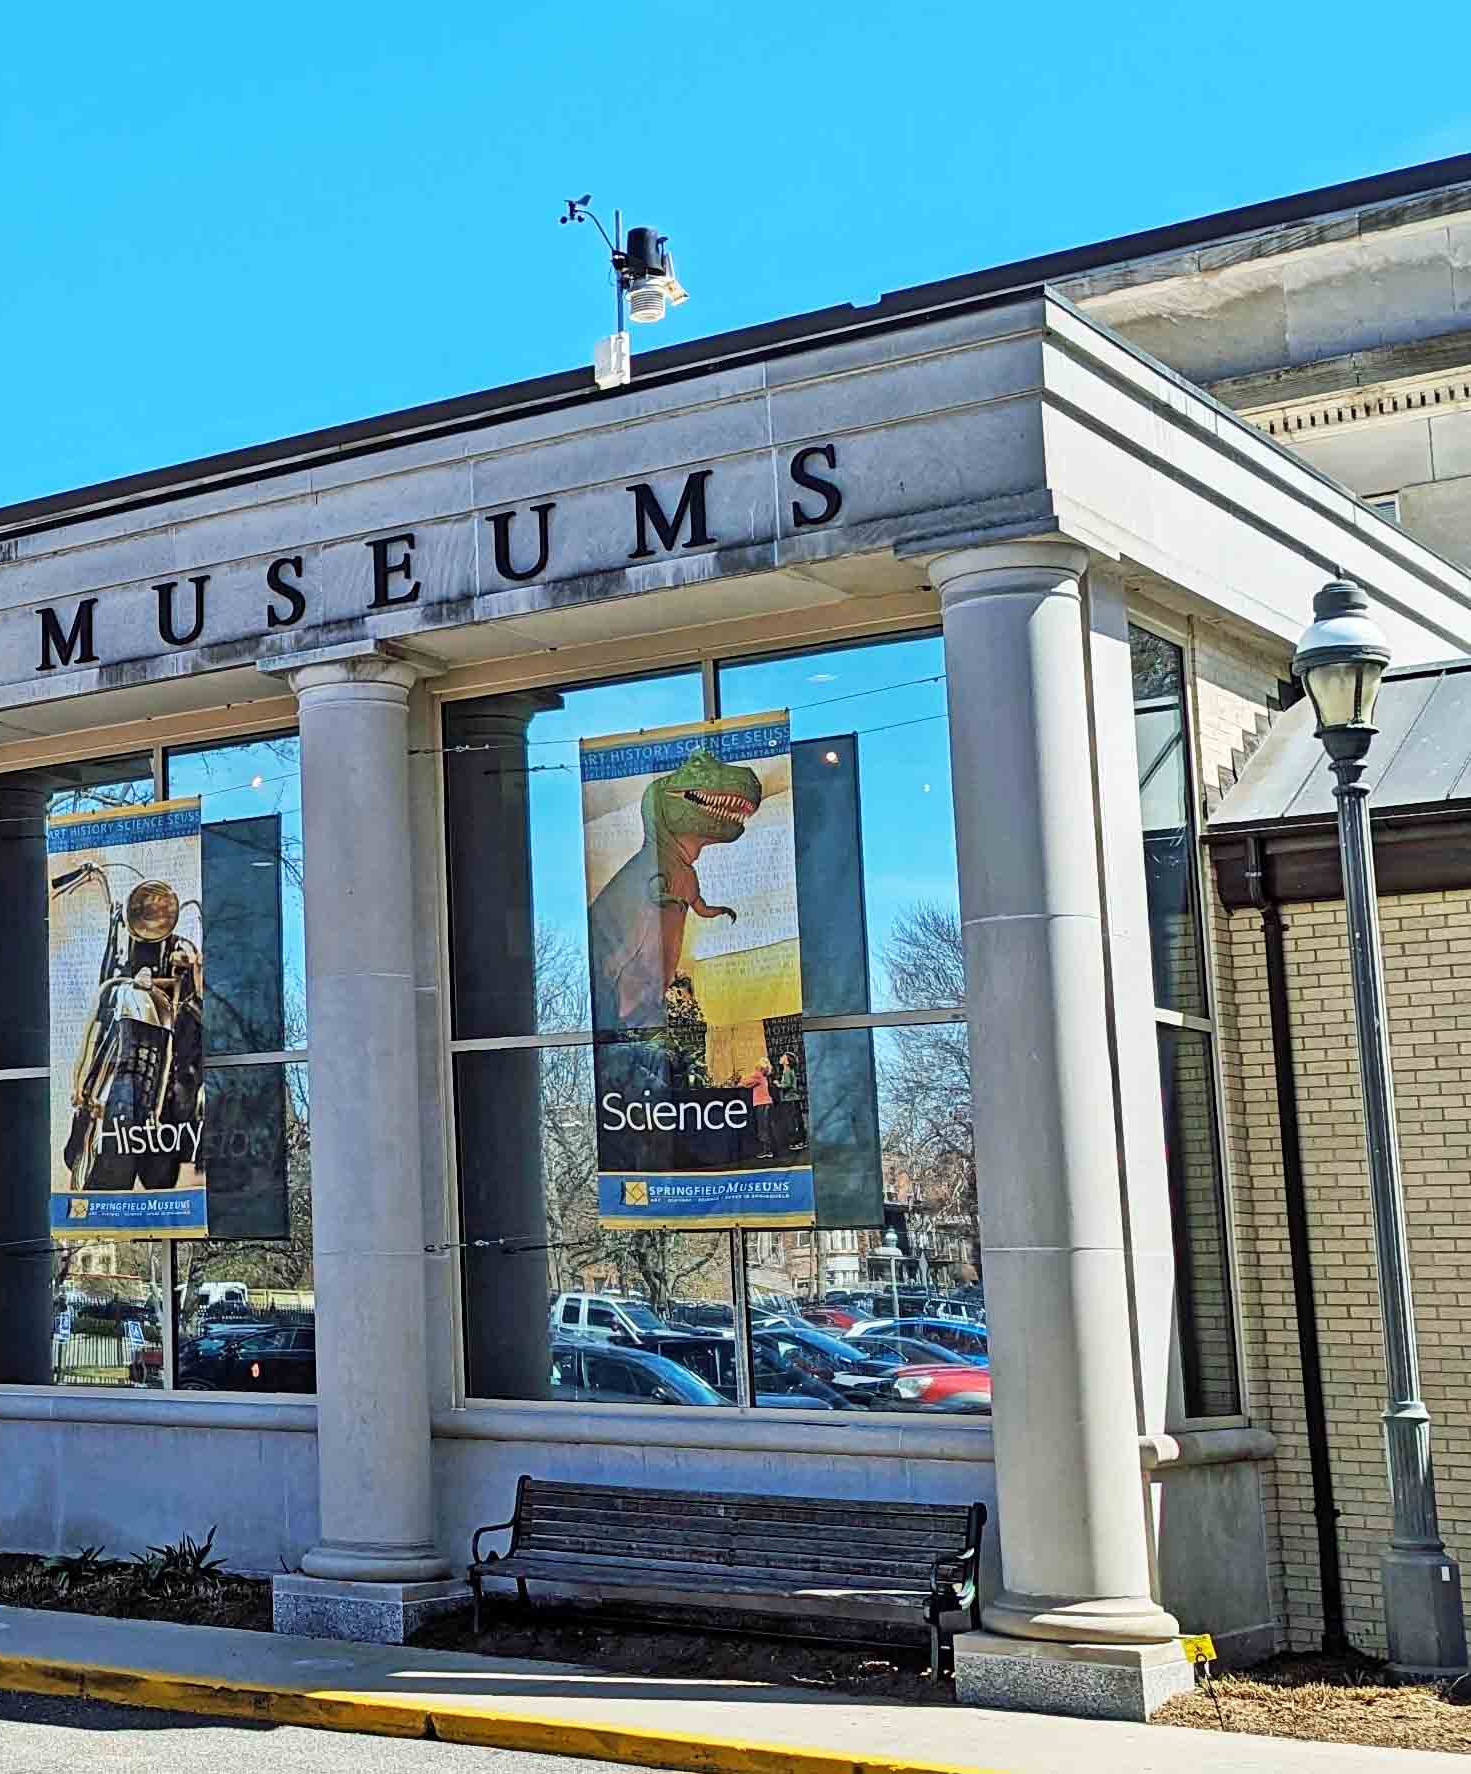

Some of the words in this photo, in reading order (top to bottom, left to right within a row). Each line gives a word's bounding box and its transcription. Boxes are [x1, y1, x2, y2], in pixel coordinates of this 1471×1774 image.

[36, 443, 843, 671] MUSEUMS
[611, 744, 670, 761] HISTORY
[678, 734, 738, 751] SCIENCE
[745, 728, 790, 744] SEUSS
[71, 822, 114, 837] HISTORY
[117, 815, 163, 831] SCIENCE
[168, 811, 200, 826] SEUSS
[602, 1090, 748, 1131] Science
[97, 1114, 204, 1162] History
